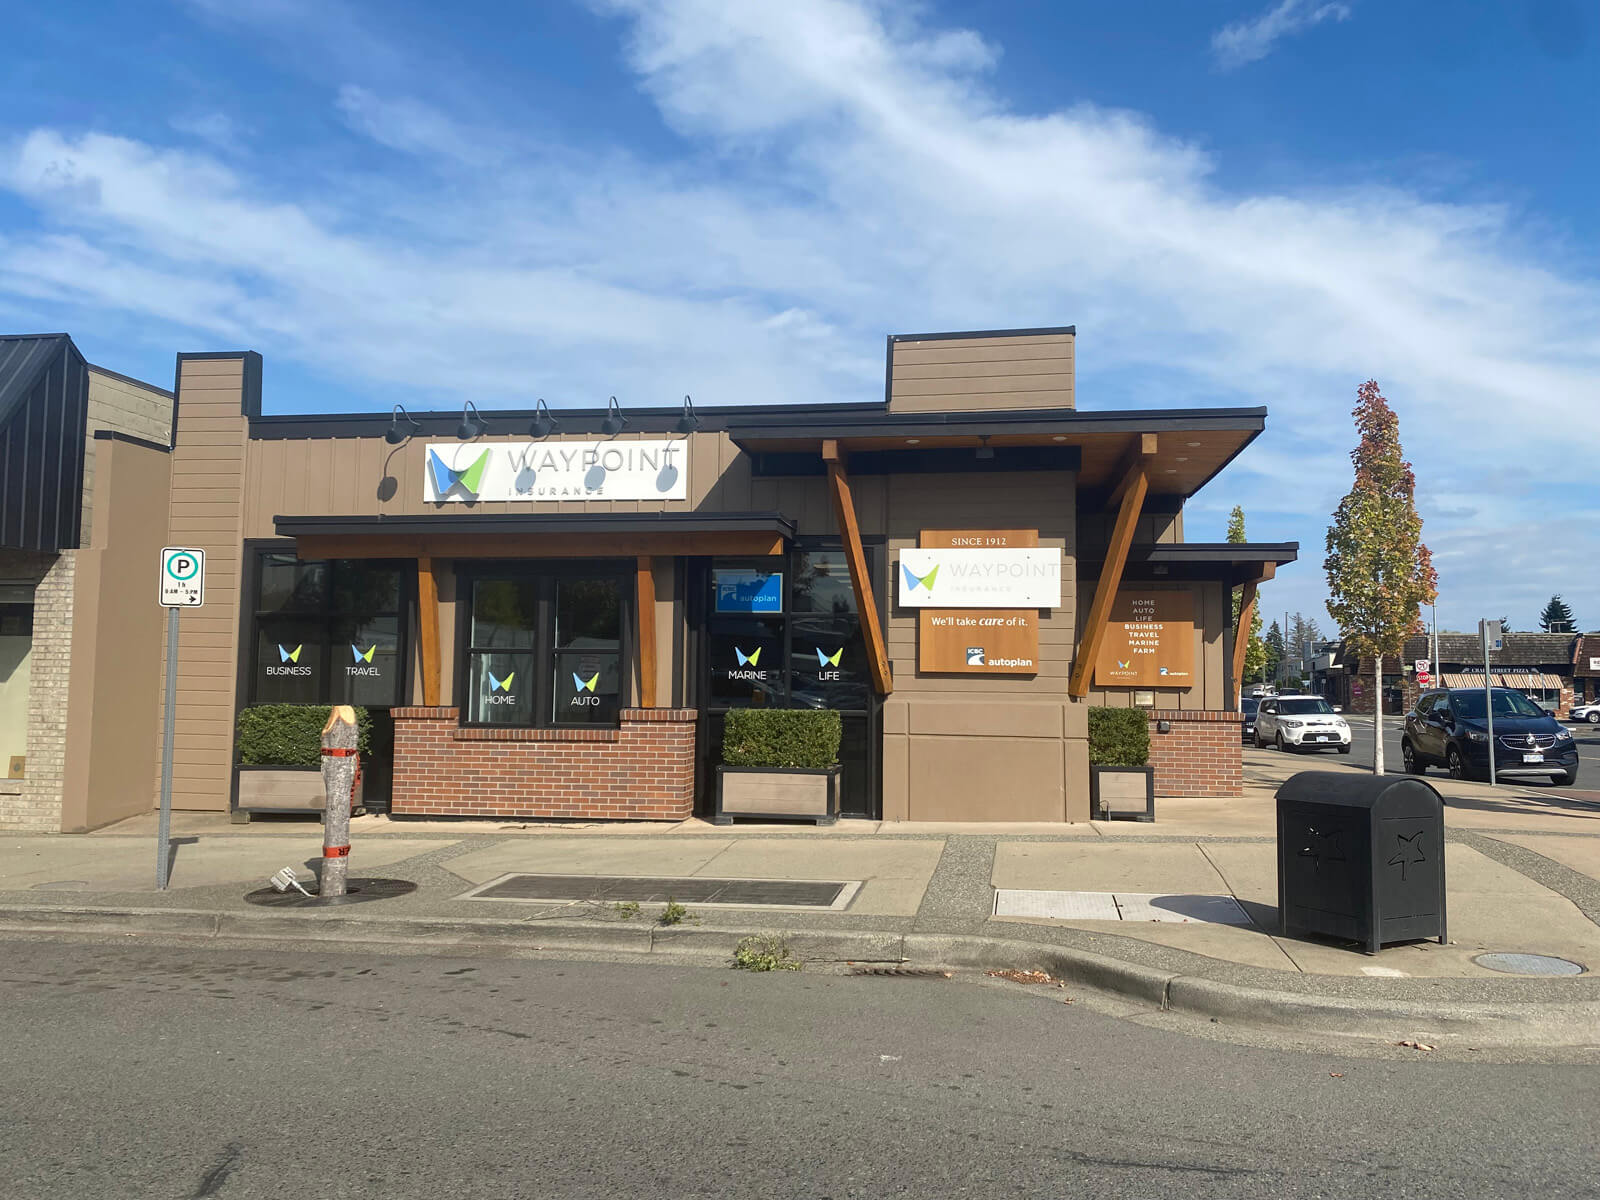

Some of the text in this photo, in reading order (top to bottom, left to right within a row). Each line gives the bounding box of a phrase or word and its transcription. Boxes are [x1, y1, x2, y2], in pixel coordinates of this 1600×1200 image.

[507, 449, 680, 473] WAYPOINT
[508, 487, 605, 497] INSURANCE
[951, 537, 1007, 546] SINCE 1912
[177, 559, 190, 573] P
[950, 563, 1059, 577] WAYPOINT
[931, 617, 1028, 626] We'll take care of it.
[988, 658, 1032, 667] autoplan
[266, 667, 312, 676] BUSINESS
[345, 667, 381, 676] TRAVEL
[728, 671, 767, 680] MARINE
[818, 672, 839, 680] LIFE
[485, 696, 516, 705] HOME
[570, 697, 600, 706] AUTO
